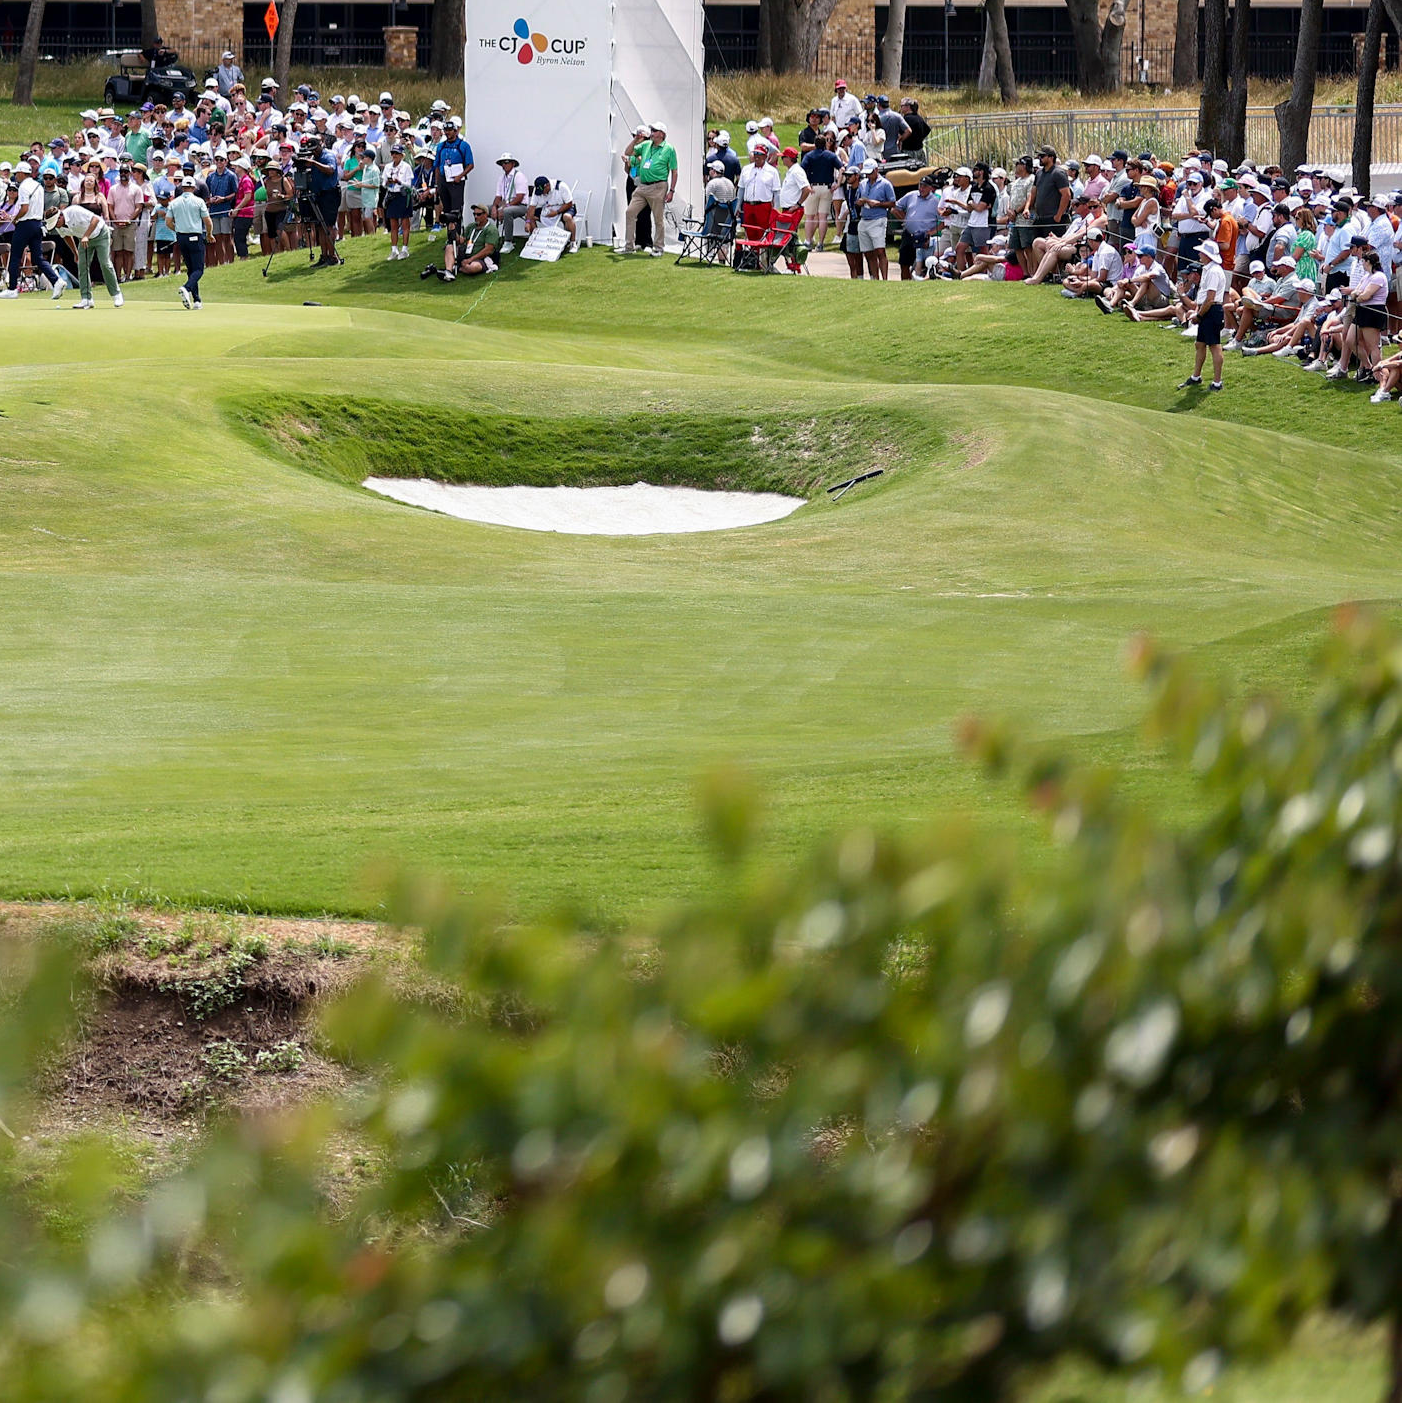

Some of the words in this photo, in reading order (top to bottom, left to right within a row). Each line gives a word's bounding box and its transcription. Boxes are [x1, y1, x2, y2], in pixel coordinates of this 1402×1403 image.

[479, 38, 496, 48] THE
[499, 36, 518, 54] CJ
[551, 39, 586, 54] CUP
[536, 56, 559, 65] Byron
[560, 57, 585, 66] Nelson
